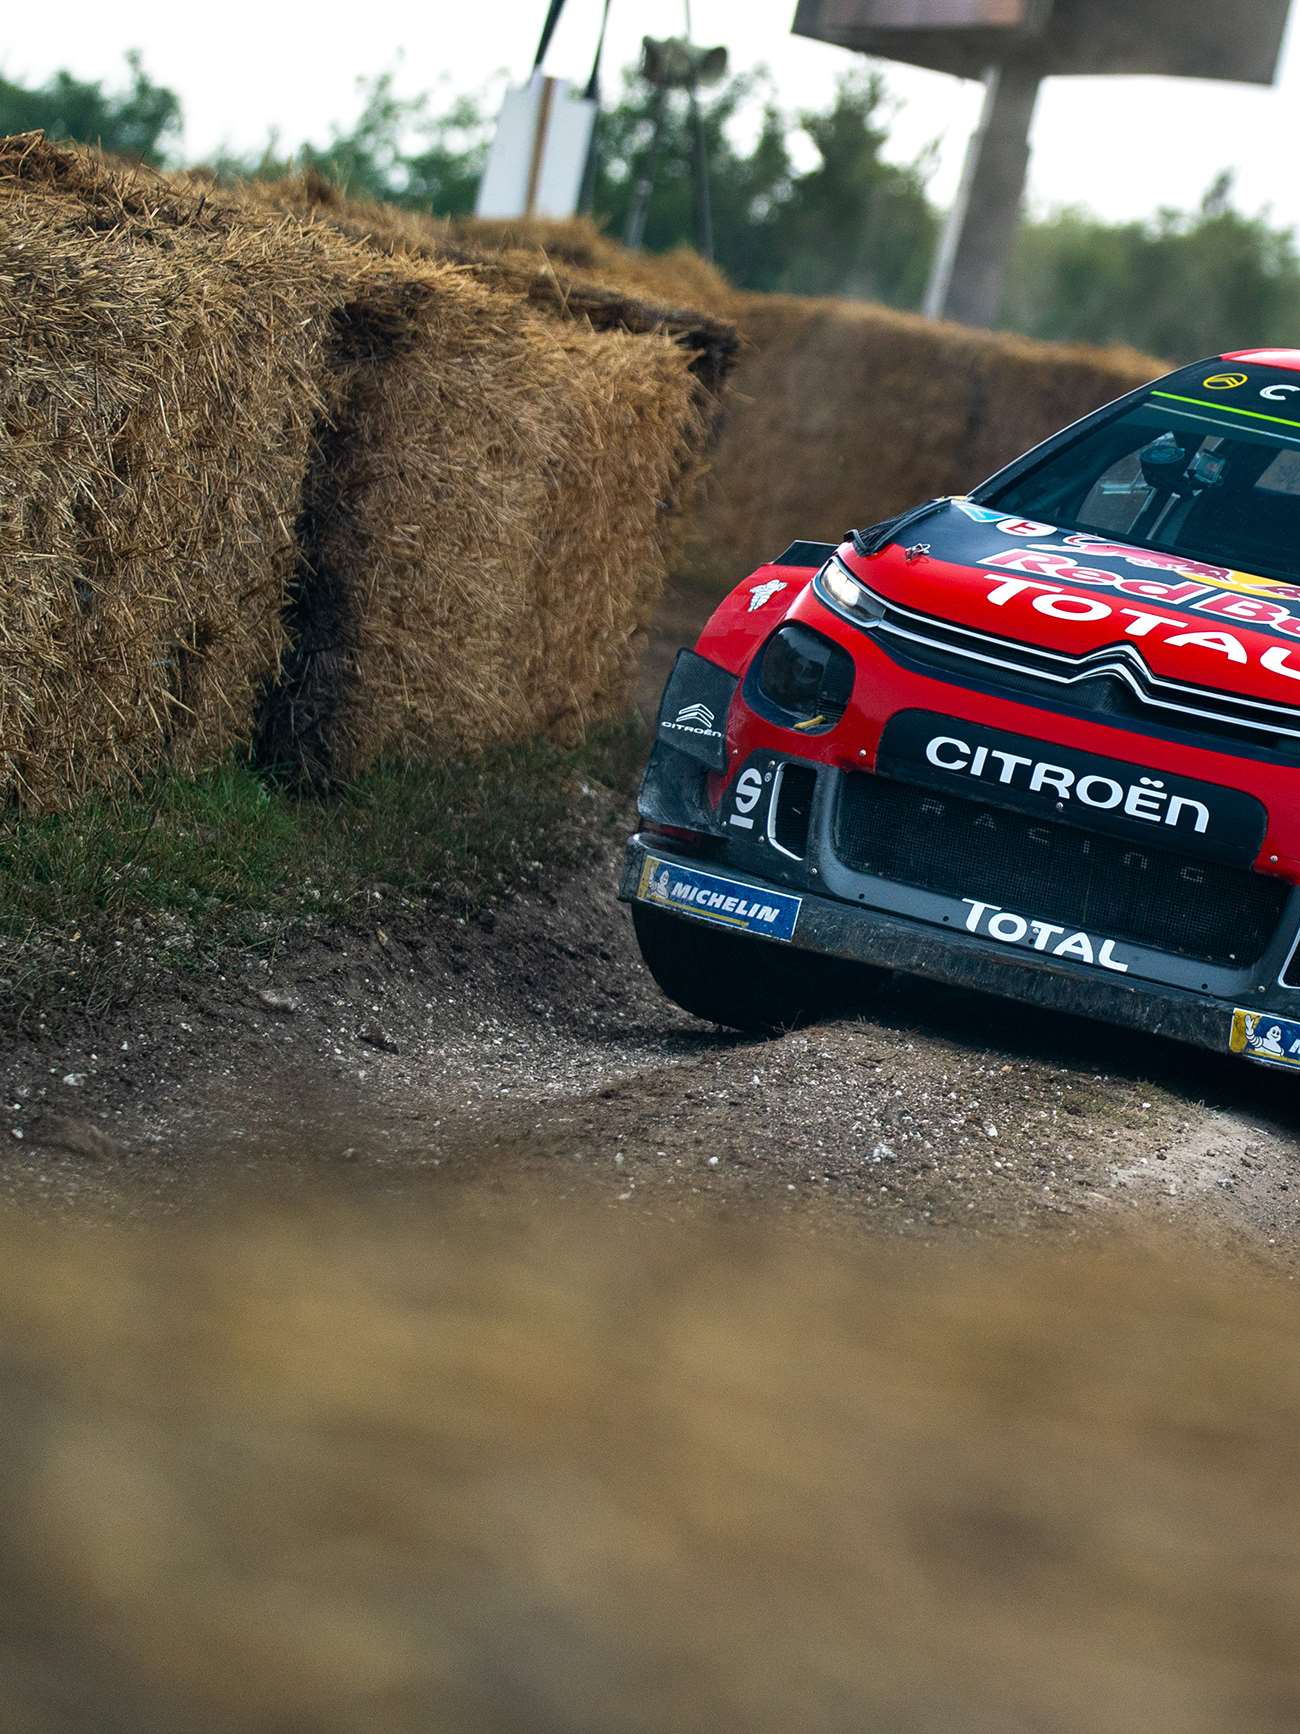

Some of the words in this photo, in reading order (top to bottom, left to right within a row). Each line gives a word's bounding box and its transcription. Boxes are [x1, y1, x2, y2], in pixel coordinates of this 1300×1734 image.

[976, 547, 1208, 605] Red
[661, 720, 722, 738] CITROËN
[925, 735, 1210, 834] CITROËN
[671, 881, 780, 923] MICHELIN
[962, 897, 1129, 974] TOTAL
